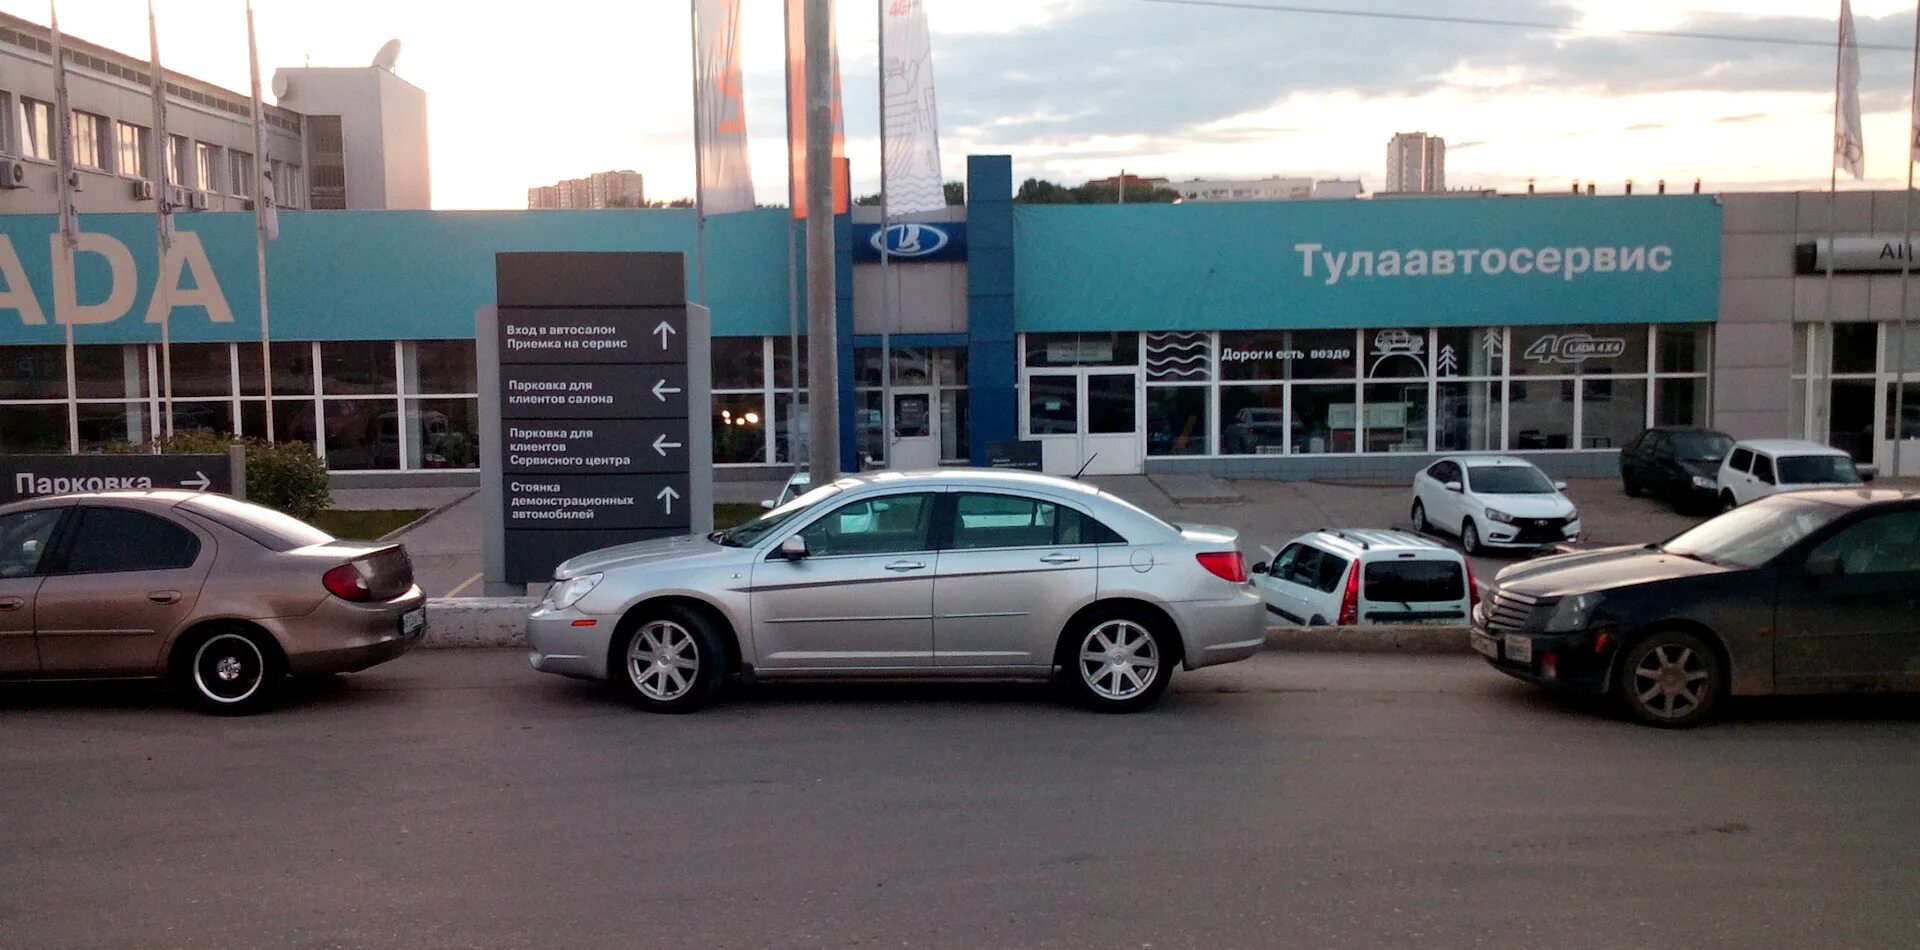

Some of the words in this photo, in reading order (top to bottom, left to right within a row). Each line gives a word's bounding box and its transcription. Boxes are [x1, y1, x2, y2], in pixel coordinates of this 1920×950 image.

[1295, 243, 1673, 286] Тулаавтосервис
[507, 325, 538, 337] Вход
[539, 326, 547, 335] в
[549, 326, 616, 336] автосалон
[507, 339, 561, 350] Приемка
[564, 340, 579, 349] на
[582, 339, 628, 350] сервис
[1221, 348, 1274, 362] Дороги
[1275, 349, 1305, 360] есть
[1310, 349, 1351, 360] везде
[509, 380, 567, 392] Парковка
[568, 381, 593, 391] для
[509, 395, 566, 404] клиентов
[567, 394, 614, 404] салона
[509, 428, 568, 440] Парковка
[569, 429, 594, 439] для
[509, 443, 567, 452] клиентов
[510, 455, 583, 467] Сервисного
[585, 456, 631, 467] центра
[16, 472, 152, 494] Парковка
[511, 482, 561, 492] Стоянка
[511, 496, 634, 507] демонстрационных
[512, 509, 594, 519] автомобилей
